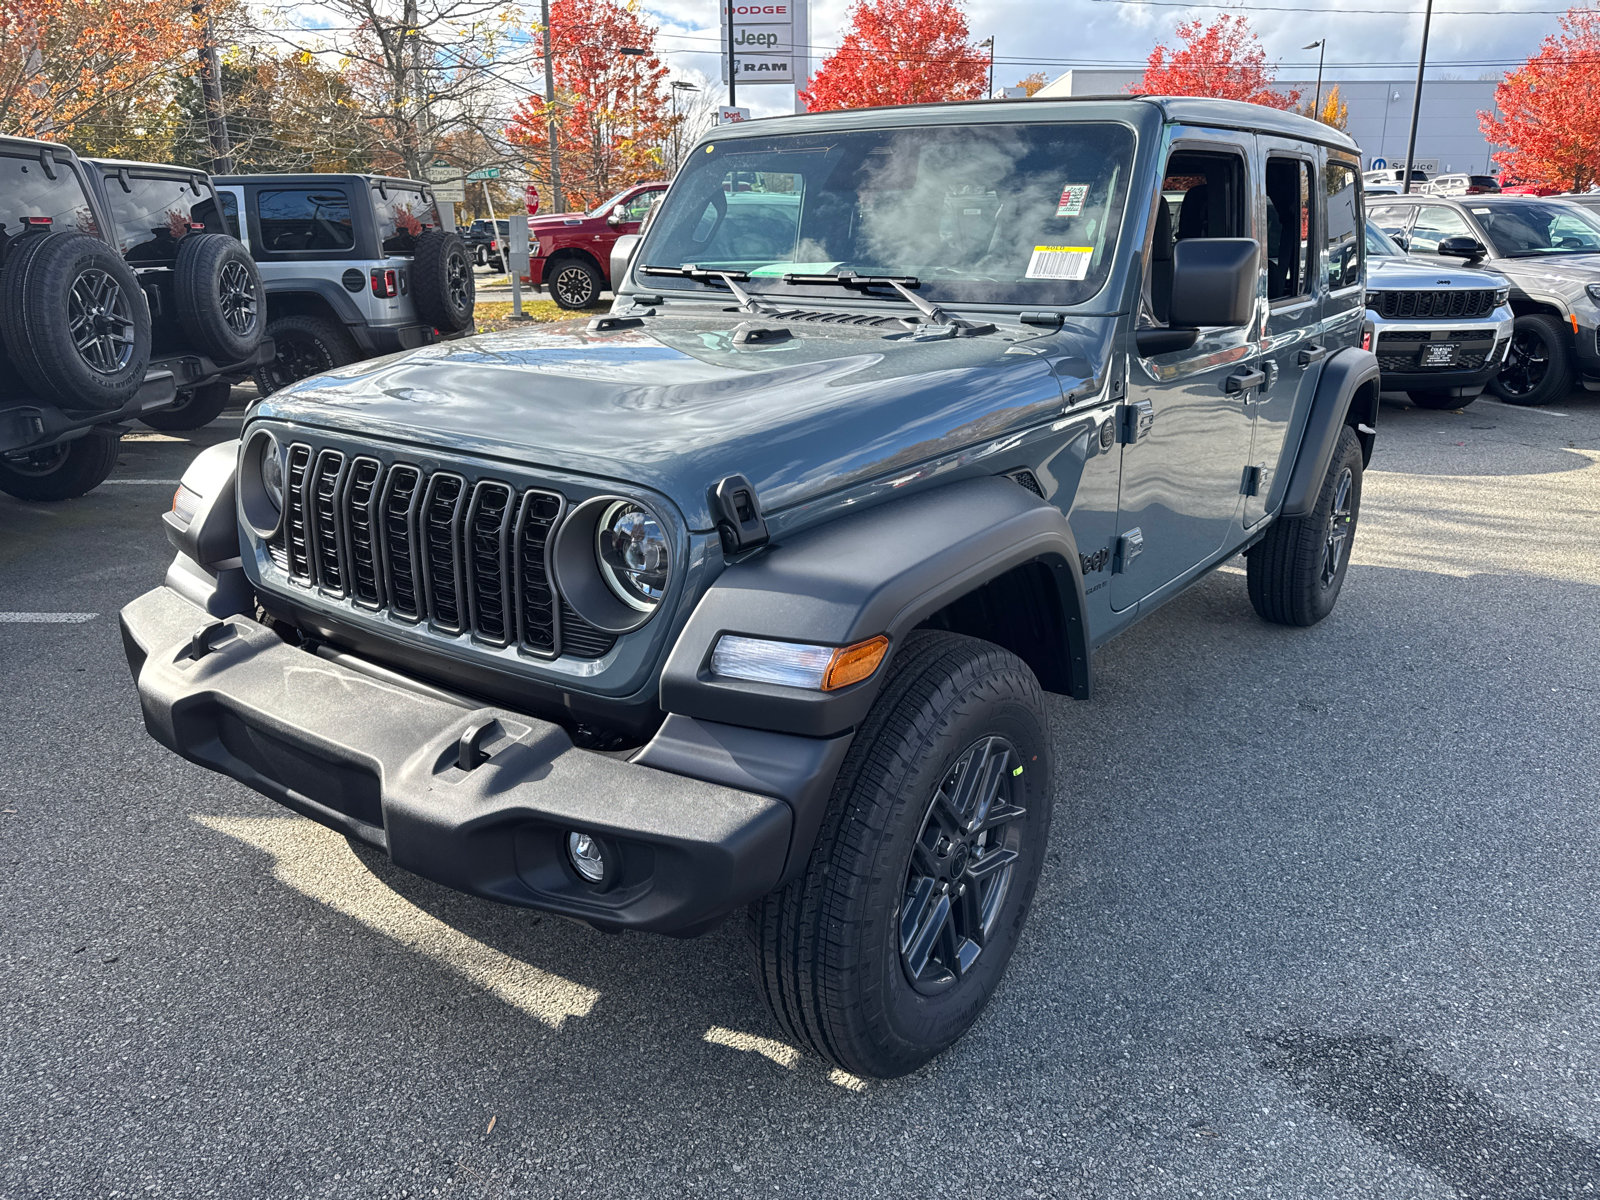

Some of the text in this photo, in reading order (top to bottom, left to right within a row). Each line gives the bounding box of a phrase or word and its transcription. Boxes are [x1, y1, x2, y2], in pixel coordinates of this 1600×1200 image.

[735, 29, 778, 48] Jeep
[743, 63, 788, 72] RAM
[1392, 162, 1433, 170] Sevice
[525, 194, 539, 207] STOP
